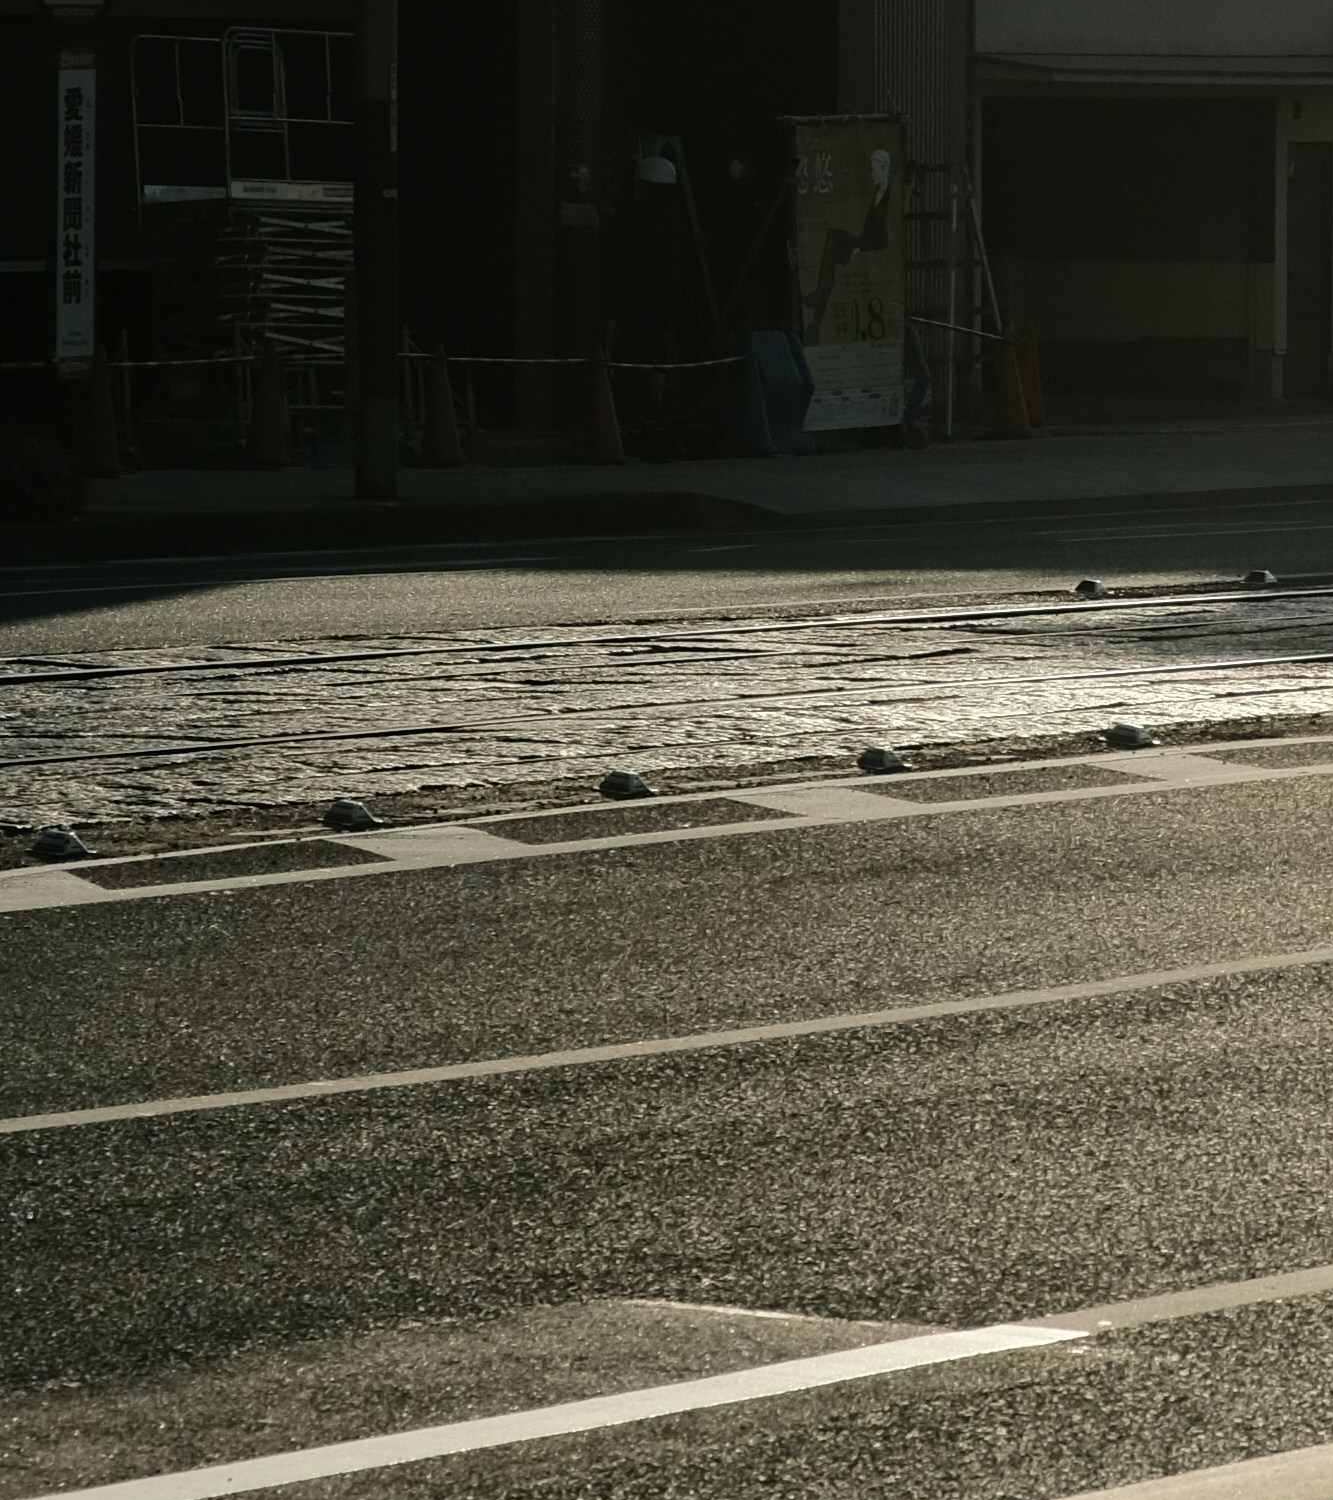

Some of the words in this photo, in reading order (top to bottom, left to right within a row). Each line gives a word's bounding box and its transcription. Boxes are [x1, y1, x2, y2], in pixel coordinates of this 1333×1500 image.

[62, 86, 83, 305] 愛媛新聞社前
